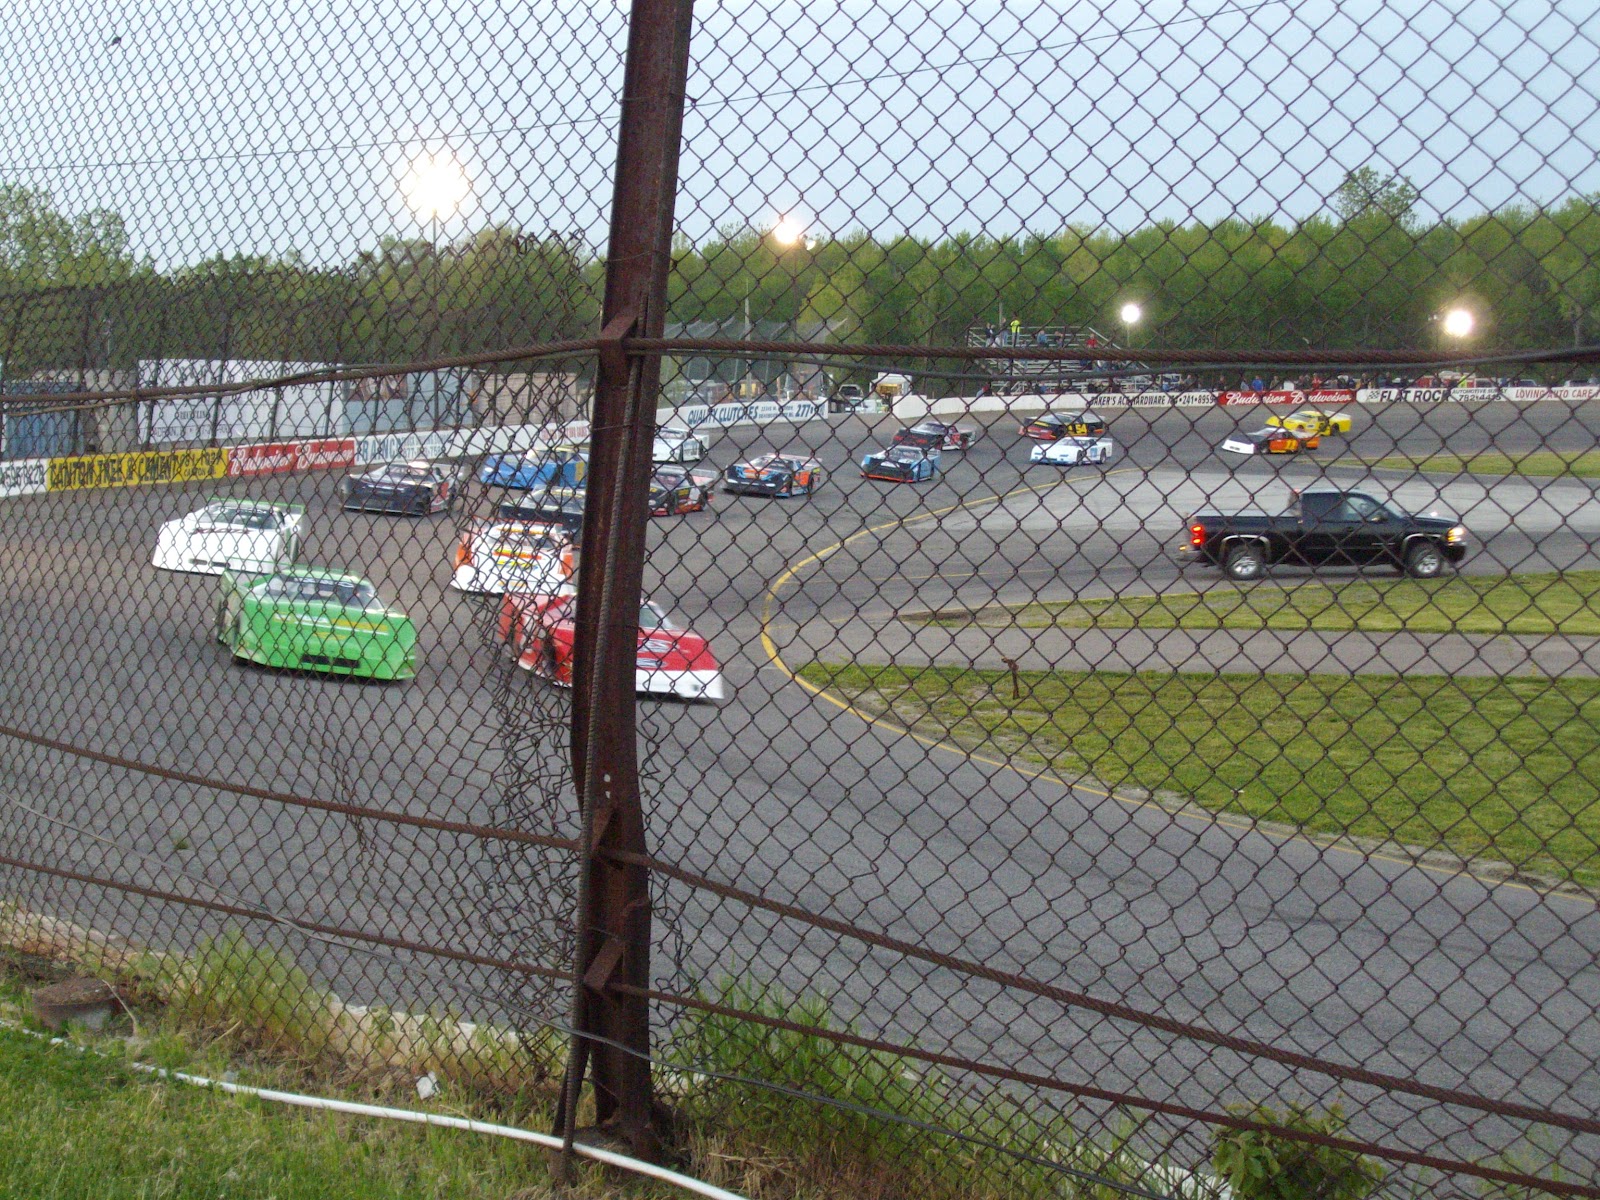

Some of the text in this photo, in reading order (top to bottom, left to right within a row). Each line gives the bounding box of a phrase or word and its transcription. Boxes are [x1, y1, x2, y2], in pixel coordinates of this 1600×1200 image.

[1226, 392, 1286, 405] Budweiser
[1380, 390, 1411, 402] FLAT
[1515, 389, 1545, 398] LOVING
[1571, 389, 1594, 398] CARE
[687, 409, 717, 424] QUALITY
